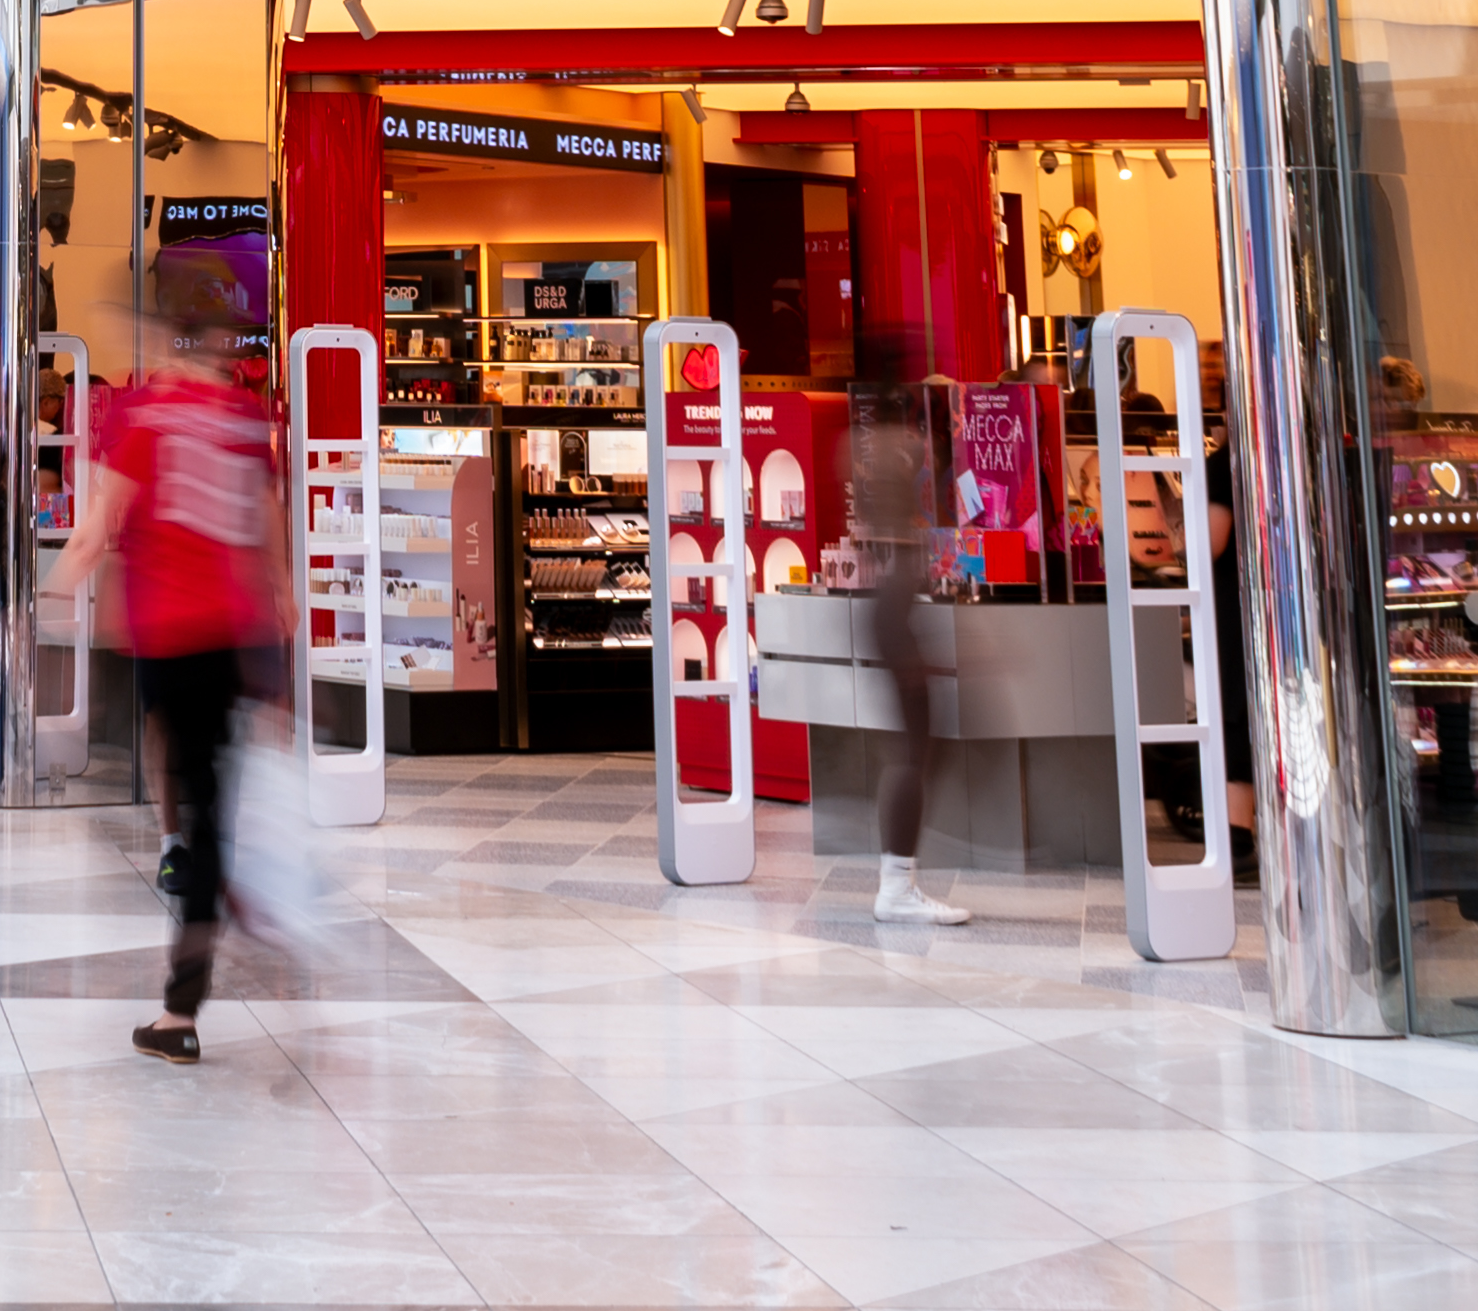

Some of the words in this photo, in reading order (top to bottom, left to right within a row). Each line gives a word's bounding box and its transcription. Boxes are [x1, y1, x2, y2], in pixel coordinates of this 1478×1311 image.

[416, 119, 529, 150] PERFUMERIA
[556, 134, 617, 158] MECCA
[384, 285, 419, 300] FORD
[534, 285, 567, 297] DS&D
[534, 298, 568, 309] URGA
[423, 410, 442, 424] ILIA
[745, 405, 774, 421] NOW
[961, 414, 1025, 443] MECCA
[974, 443, 1014, 472] MAX
[465, 521, 480, 565] ILIA
